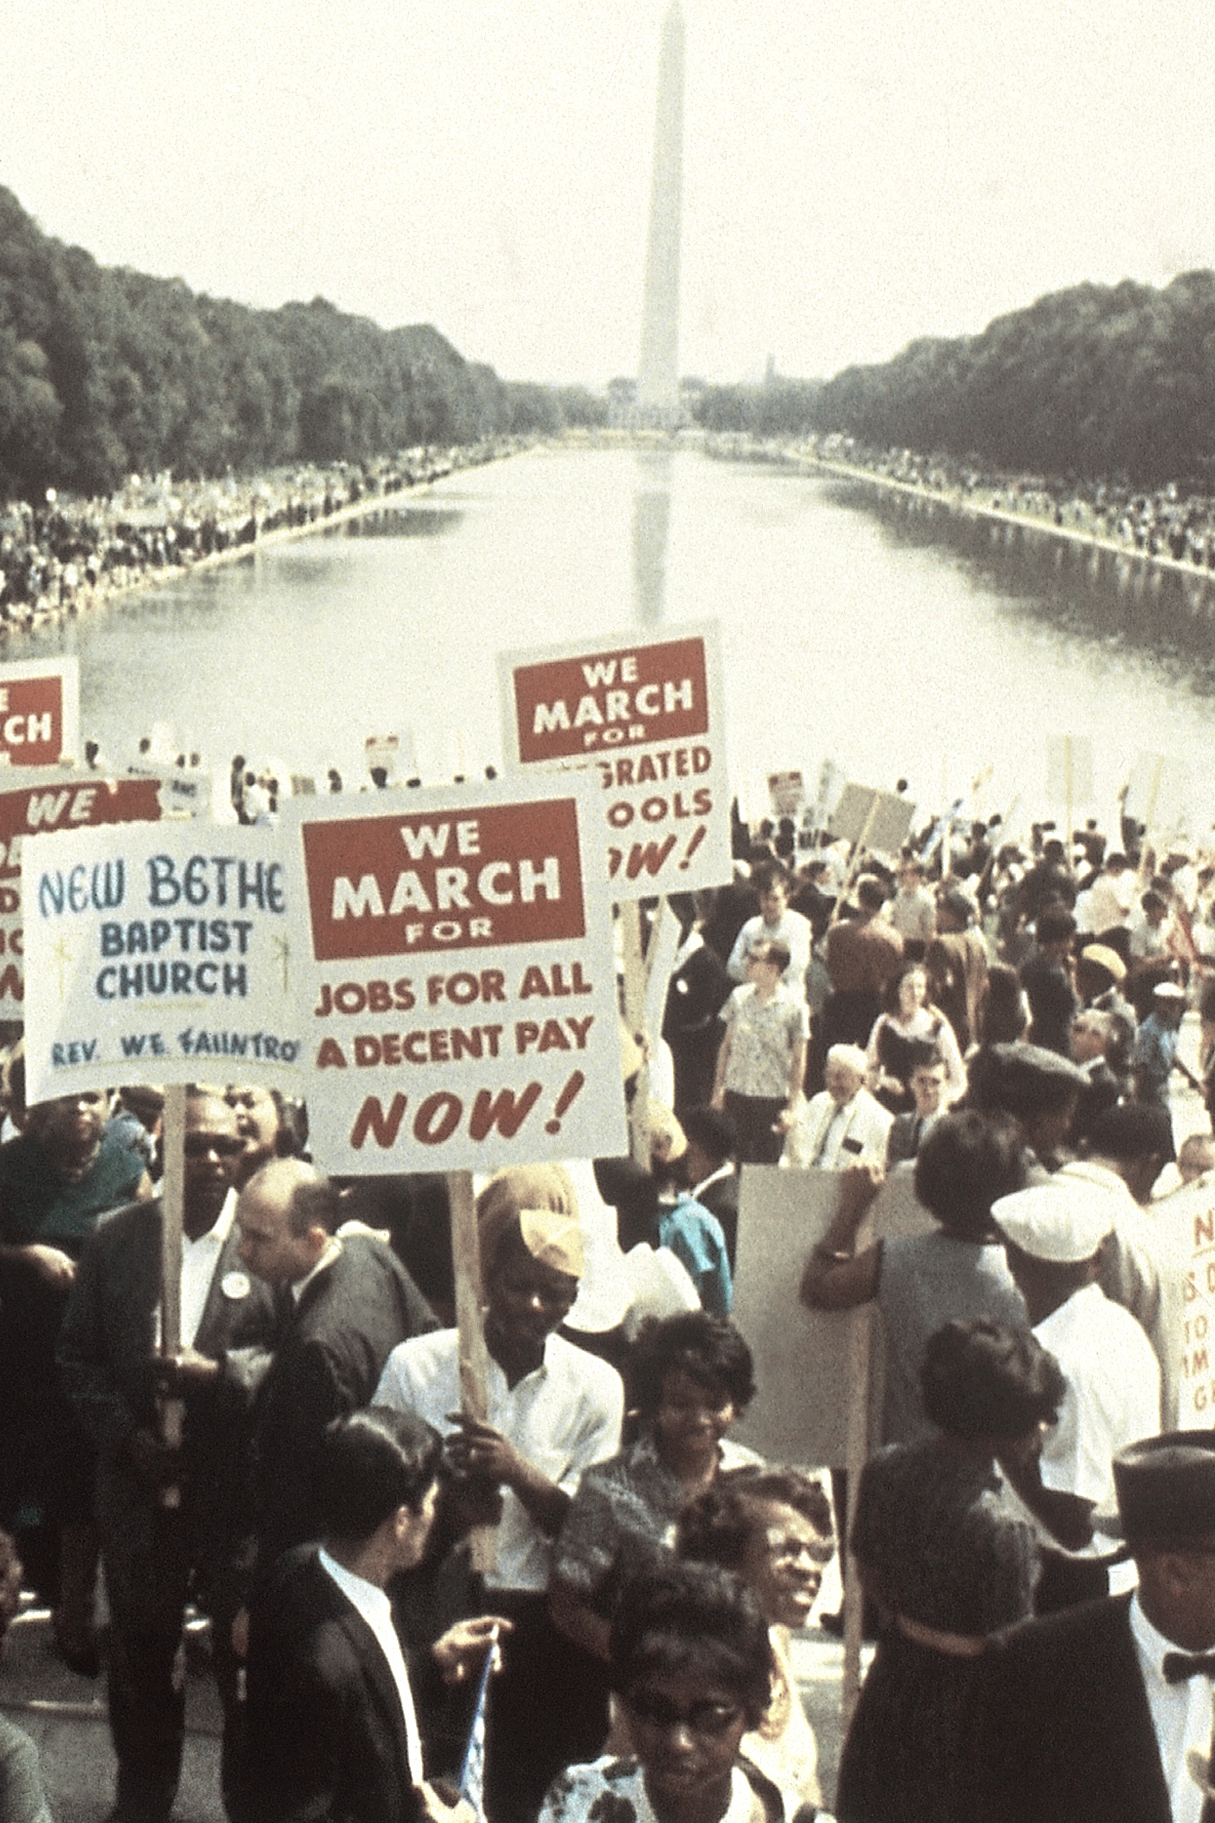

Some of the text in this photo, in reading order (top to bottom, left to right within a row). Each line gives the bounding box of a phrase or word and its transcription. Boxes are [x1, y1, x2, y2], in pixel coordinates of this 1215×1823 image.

[583, 657, 638, 688] WE
[534, 680, 693, 734] MARCH
[584, 724, 645, 747] FOR
[26, 789, 98, 827] WE
[401, 820, 481, 860] WE
[37, 859, 125, 918] NEW
[331, 856, 562, 920] MARCH
[101, 918, 253, 957] BAPTIST
[405, 918, 493, 944] FOR
[96, 961, 249, 999] CHURCH
[315, 960, 593, 1017] JOBS FOR ALL
[317, 1015, 595, 1070] A DECENT PAY
[350, 1069, 585, 1150] NOW!
